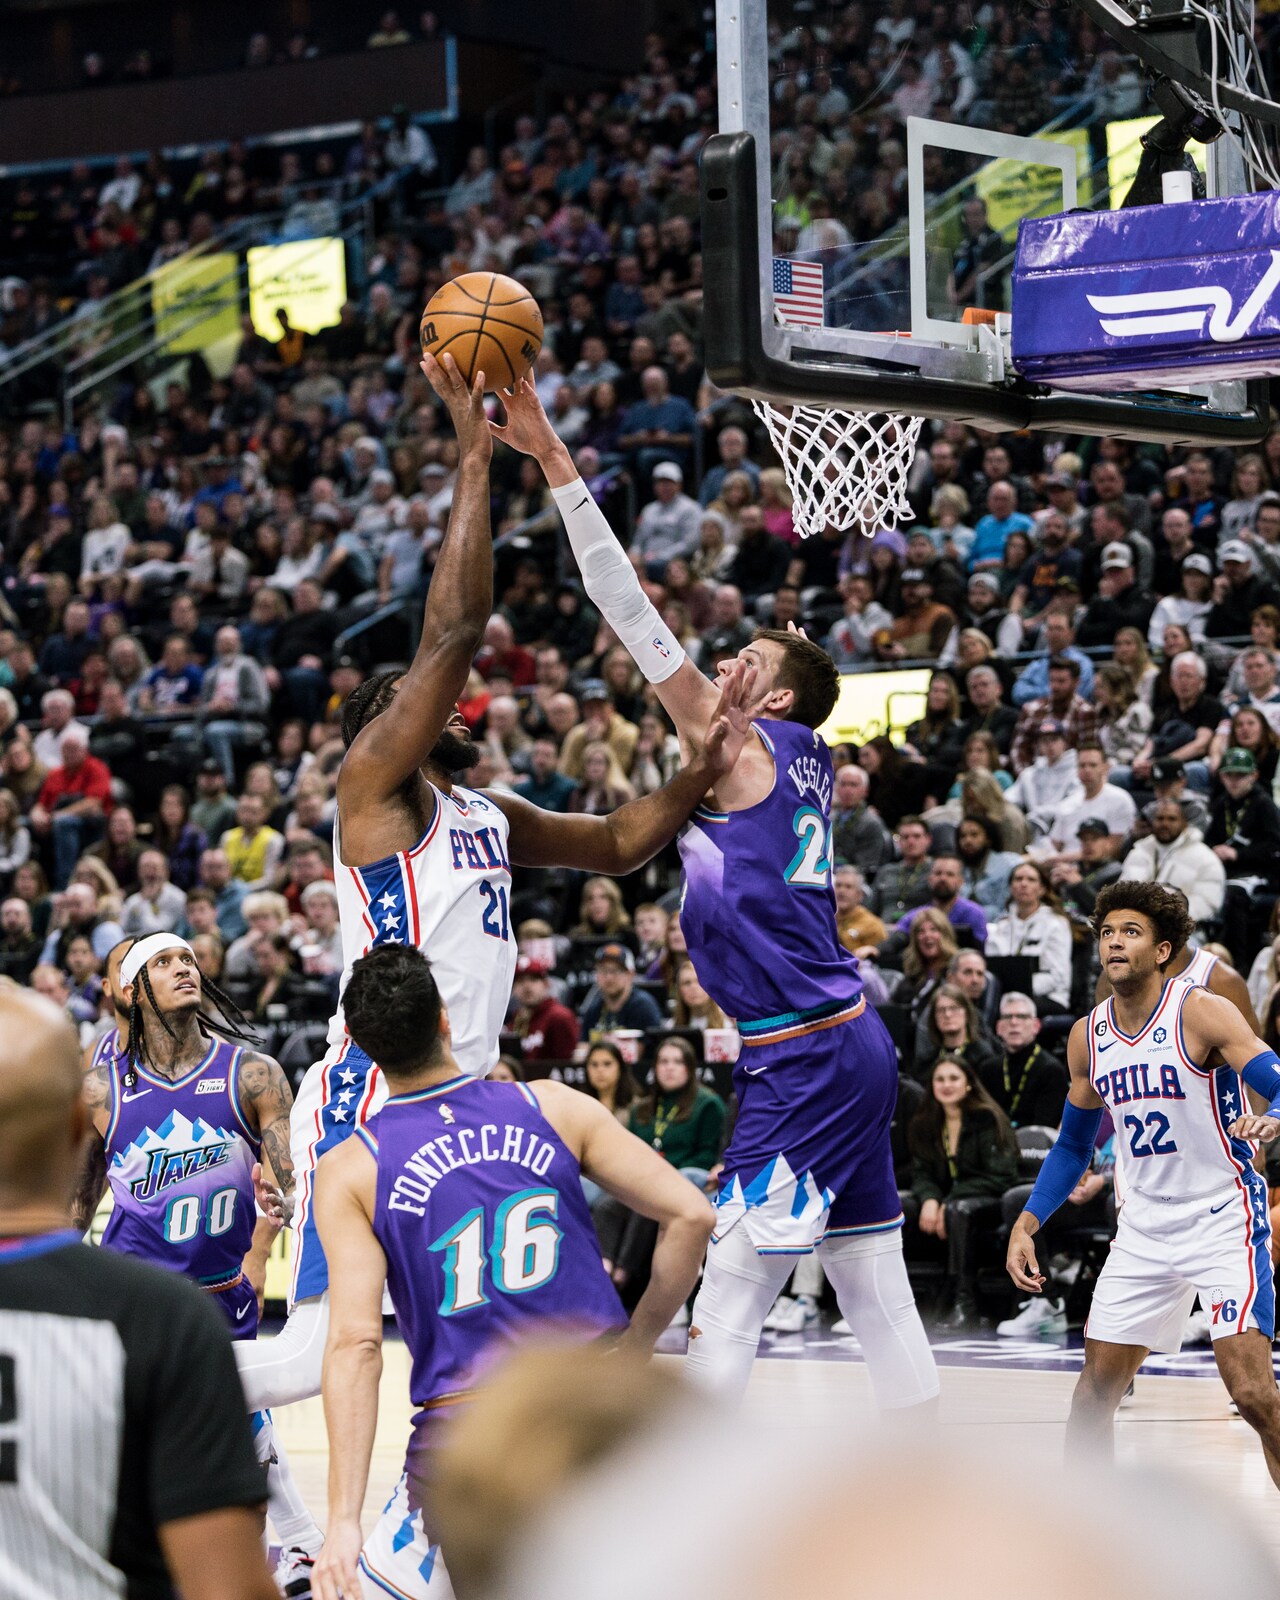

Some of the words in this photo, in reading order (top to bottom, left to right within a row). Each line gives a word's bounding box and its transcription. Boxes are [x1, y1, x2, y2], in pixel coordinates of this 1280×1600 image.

[449, 827, 512, 877] PHIL
[783, 805, 834, 888] 2
[479, 879, 508, 942] 21
[1098, 1022, 1107, 1035] 6
[1147, 1045, 1173, 1053] crypto.com
[198, 1081, 206, 1092] 5
[1095, 1063, 1187, 1106] PHILA
[1123, 1110, 1178, 1158] 22
[387, 1124, 556, 1217] FONTECCHIO
[163, 1186, 239, 1244] 00
[426, 1187, 565, 1317] 16
[1211, 1299, 1238, 1326] 76
